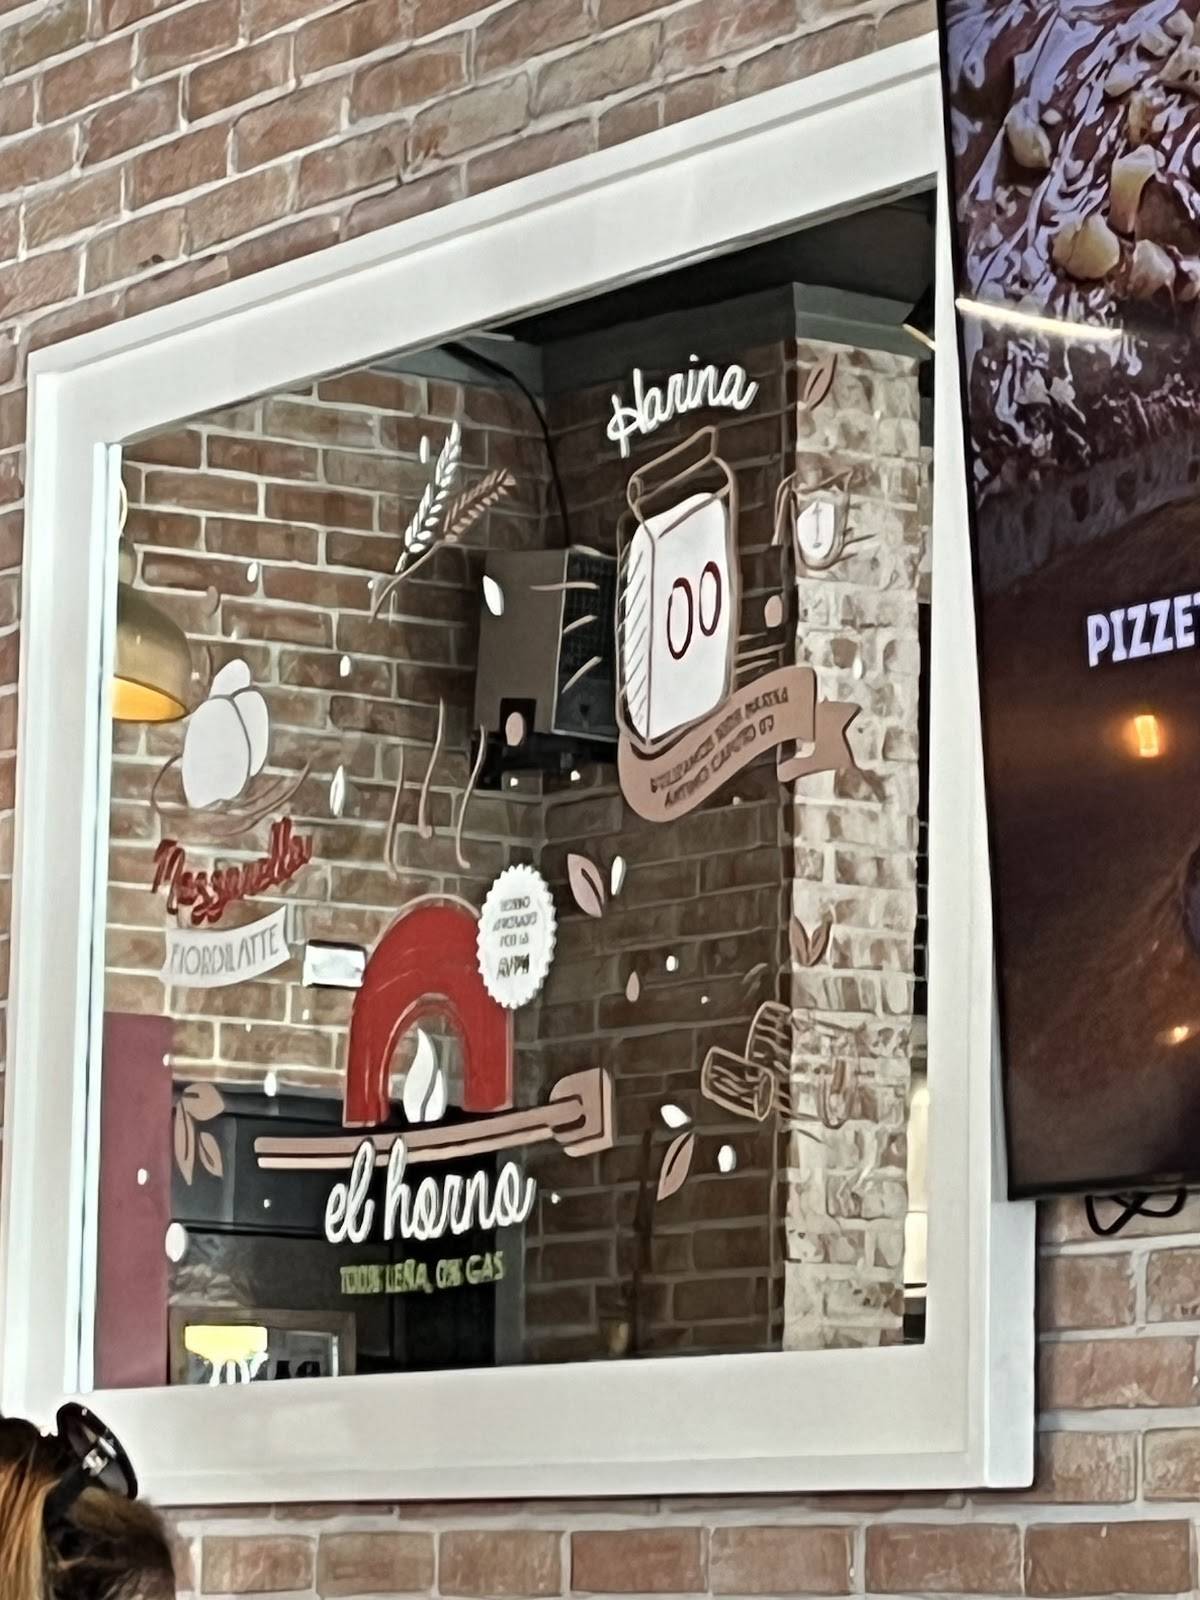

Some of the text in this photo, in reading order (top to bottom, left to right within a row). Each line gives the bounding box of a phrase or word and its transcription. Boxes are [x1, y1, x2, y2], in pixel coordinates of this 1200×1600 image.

[607, 353, 759, 458] Harina
[667, 561, 722, 660] 00
[325, 1137, 536, 1243] el horno
[465, 1251, 504, 1285] GAS
